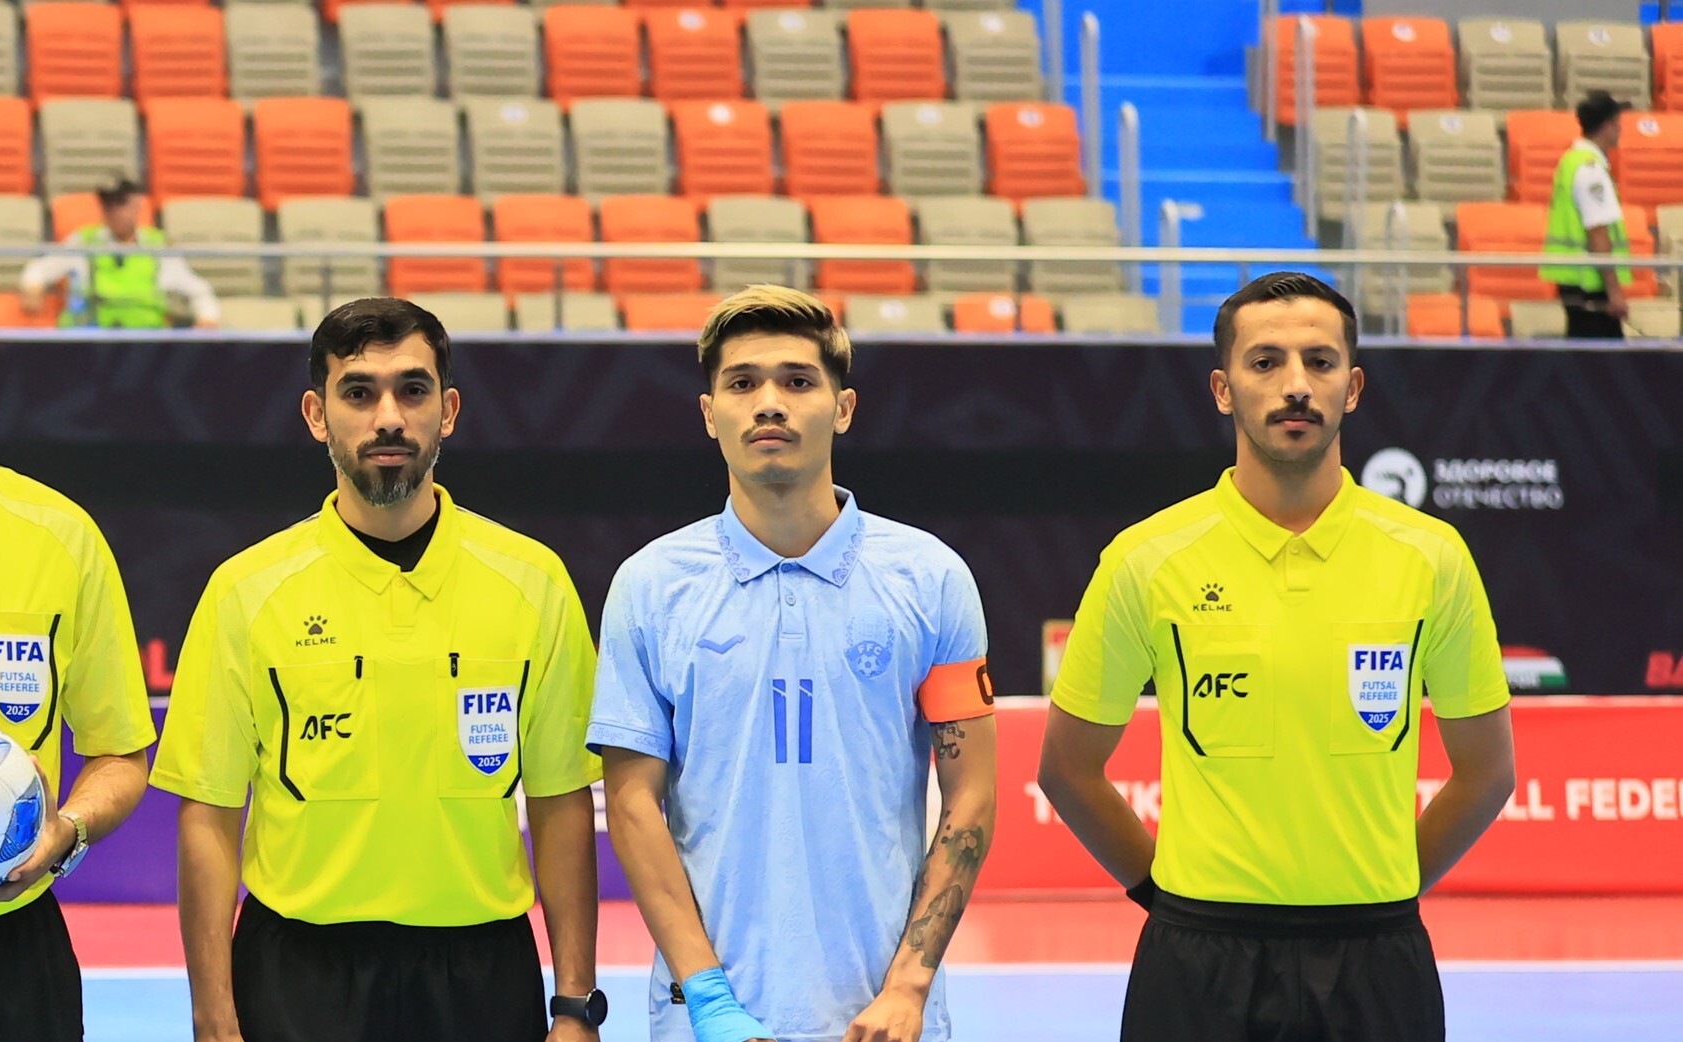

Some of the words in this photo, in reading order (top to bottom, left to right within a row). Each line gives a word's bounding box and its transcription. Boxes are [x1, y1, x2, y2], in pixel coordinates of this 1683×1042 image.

[1193, 603, 1232, 612] KELME
[295, 637, 337, 647] KELME
[1354, 650, 1403, 670] FIFA
[0, 671, 37, 682] FUTSAL
[1192, 673, 1249, 698] AFC
[1362, 681, 1397, 690] FUTSAL
[1359, 691, 1398, 701] REFEREE
[463, 692, 512, 715] FIFA
[5, 705, 30, 716] 2025
[772, 679, 813, 764] 11
[1368, 713, 1389, 724] 2025
[299, 713, 352, 740] AFC
[470, 723, 506, 734] FUTSAL
[468, 733, 509, 745] REFEREE
[477, 756, 501, 767] 2025
